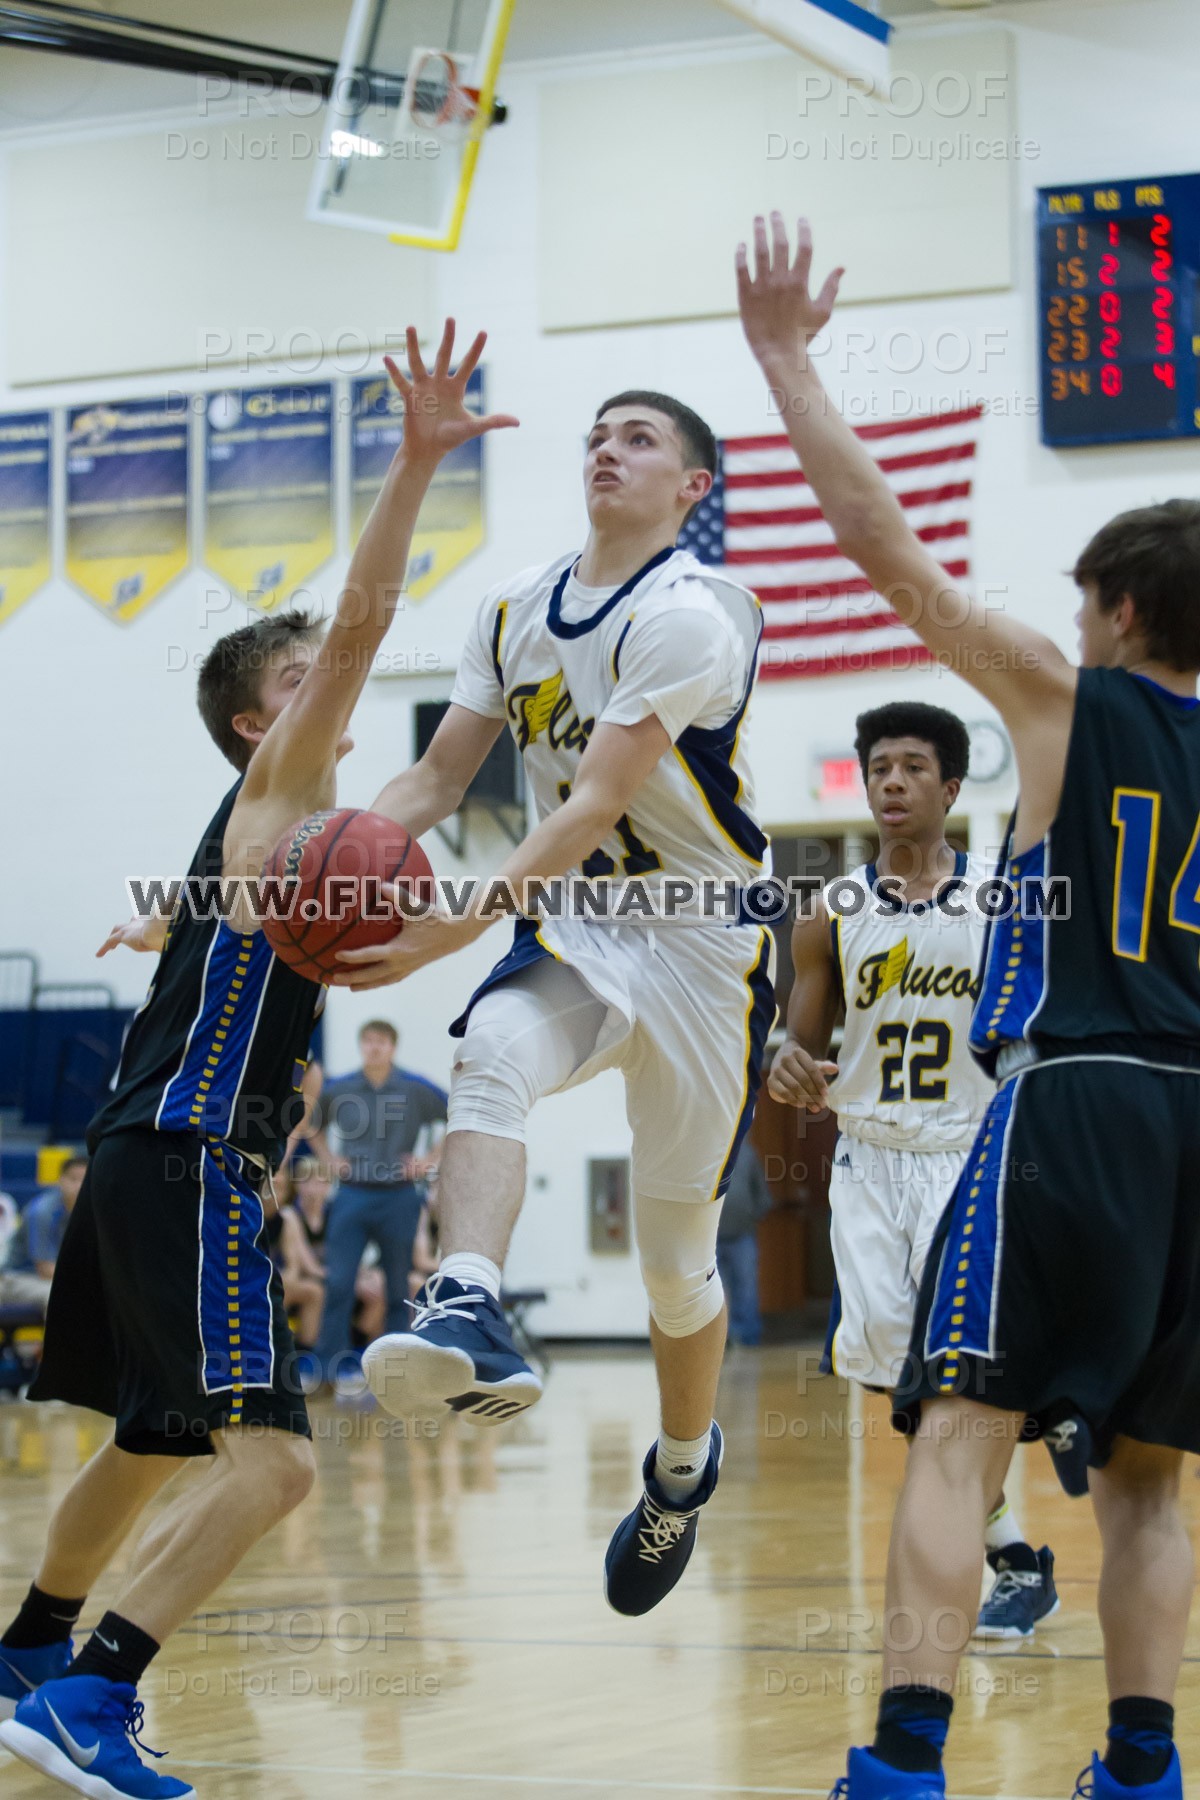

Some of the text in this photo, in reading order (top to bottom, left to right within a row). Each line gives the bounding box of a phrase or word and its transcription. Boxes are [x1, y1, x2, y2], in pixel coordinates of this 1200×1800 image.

[1108, 220, 1121, 248] 1
[1151, 213, 1172, 247] 2
[1056, 249, 1173, 289] 15 2 2
[1048, 294, 1090, 328] 22
[1152, 286, 1174, 320] 2
[1048, 329, 1090, 363] 23
[1100, 326, 1121, 359] 2
[1154, 322, 1175, 355] 3
[1051, 366, 1092, 401] 34
[875, 1018, 953, 1103] 22
